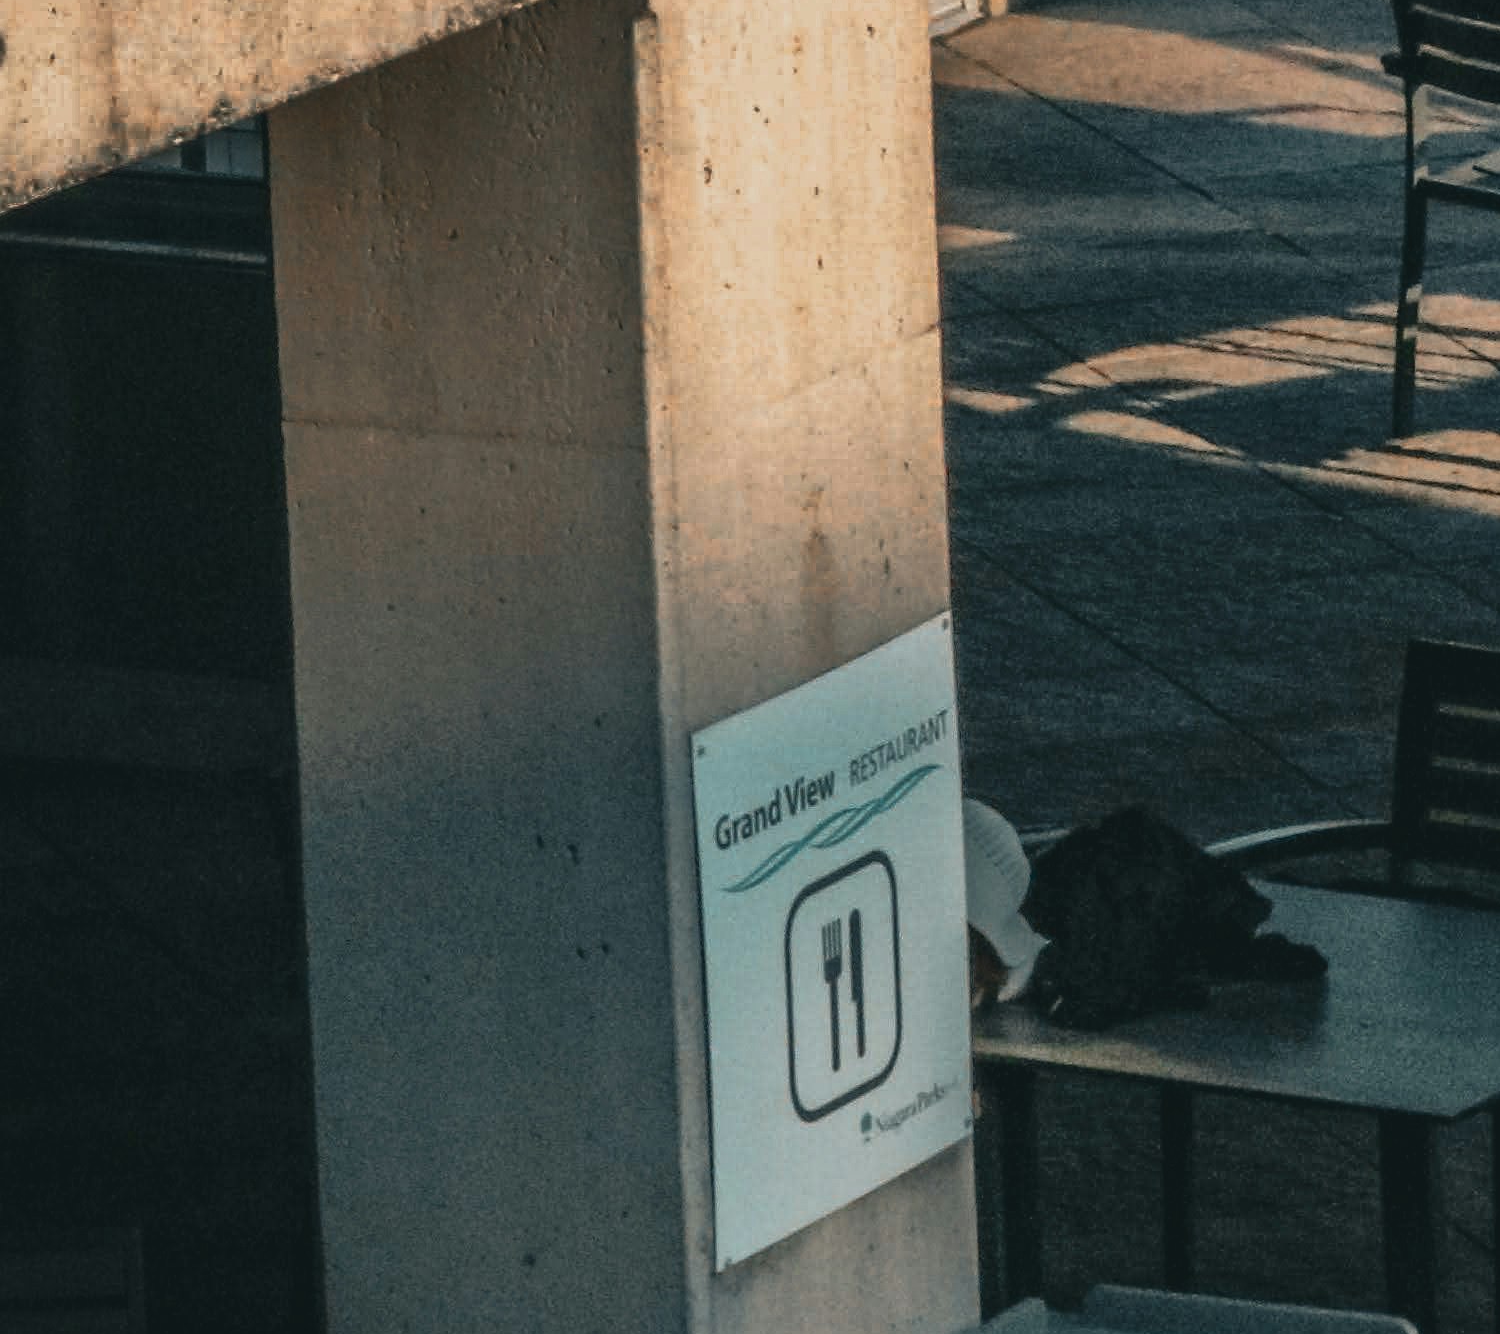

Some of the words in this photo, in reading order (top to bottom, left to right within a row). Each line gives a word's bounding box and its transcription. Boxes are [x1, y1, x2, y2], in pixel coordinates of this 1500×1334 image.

[714, 788, 783, 851] Grand
[784, 771, 836, 817] View
[849, 709, 949, 786] RESTAURANT
